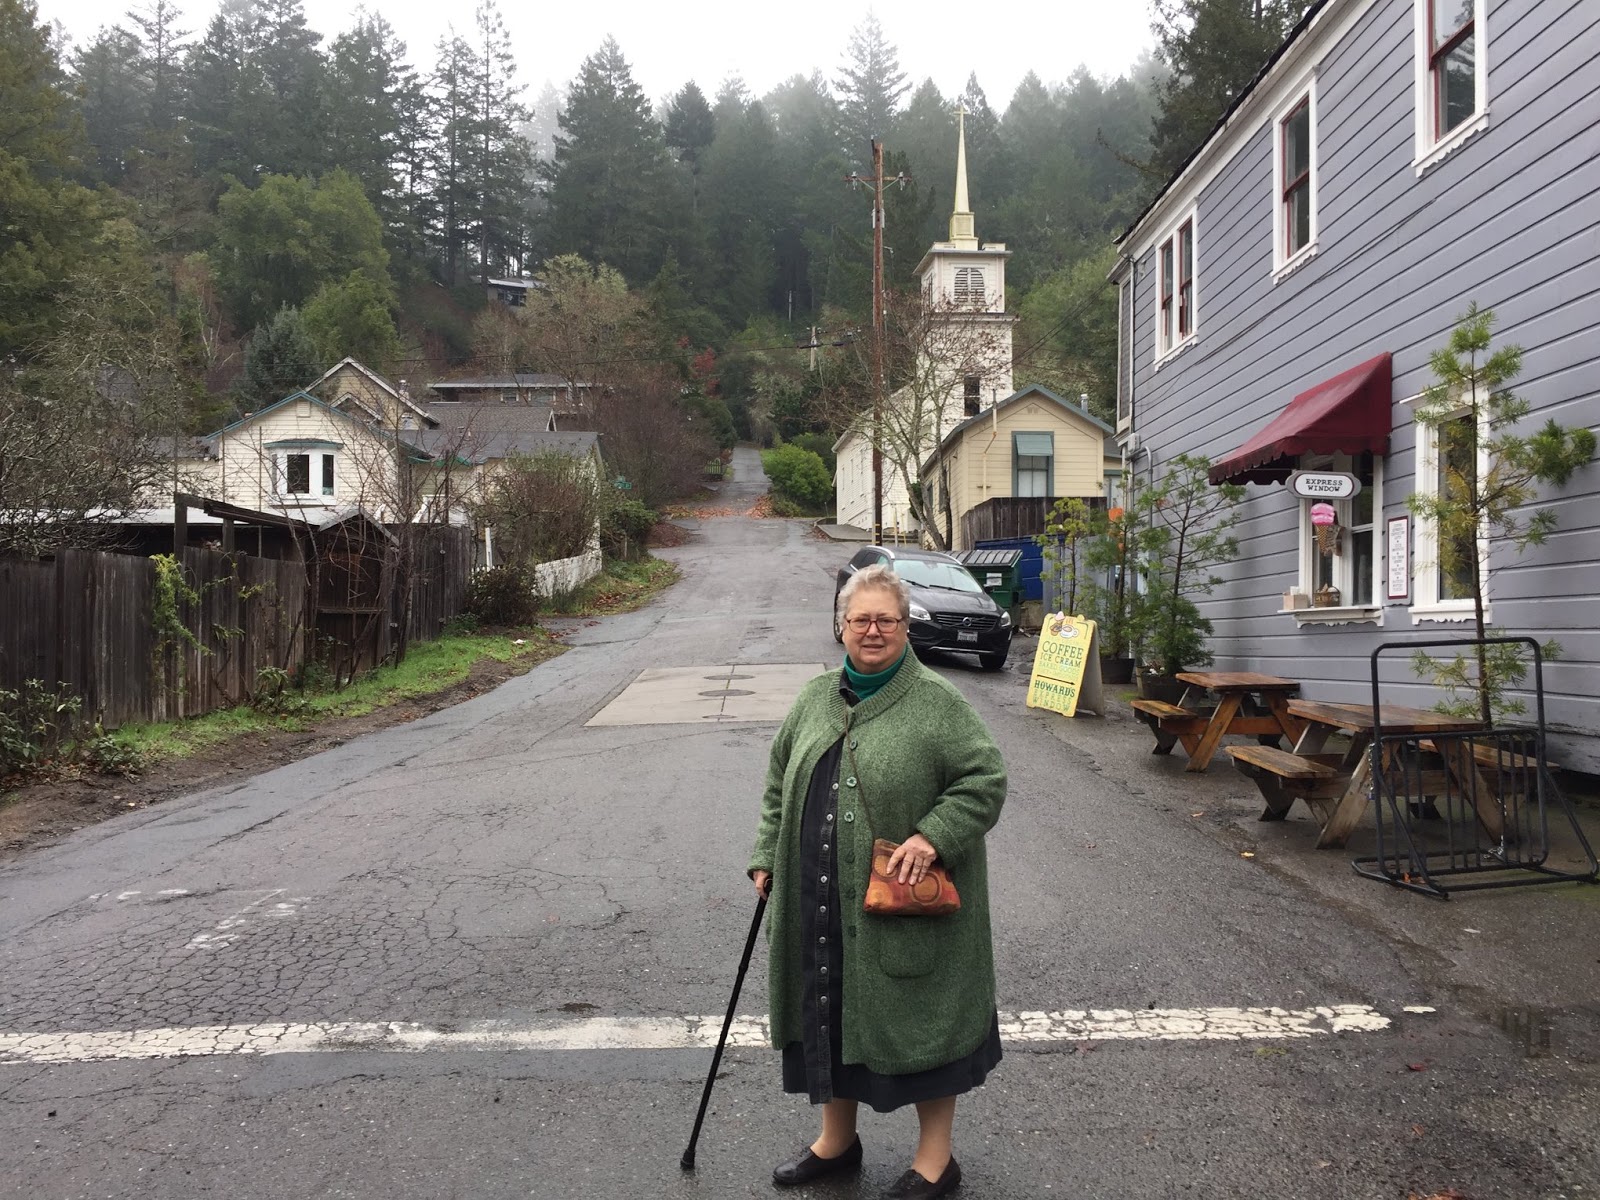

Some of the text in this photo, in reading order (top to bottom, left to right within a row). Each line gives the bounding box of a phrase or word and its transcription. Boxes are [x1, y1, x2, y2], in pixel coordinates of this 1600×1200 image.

[1042, 641, 1083, 659] COFFEE
[1040, 652, 1081, 667] ICE CREAM
[1034, 689, 1071, 704] EXPRESS
[1033, 698, 1070, 711] WINDOW
